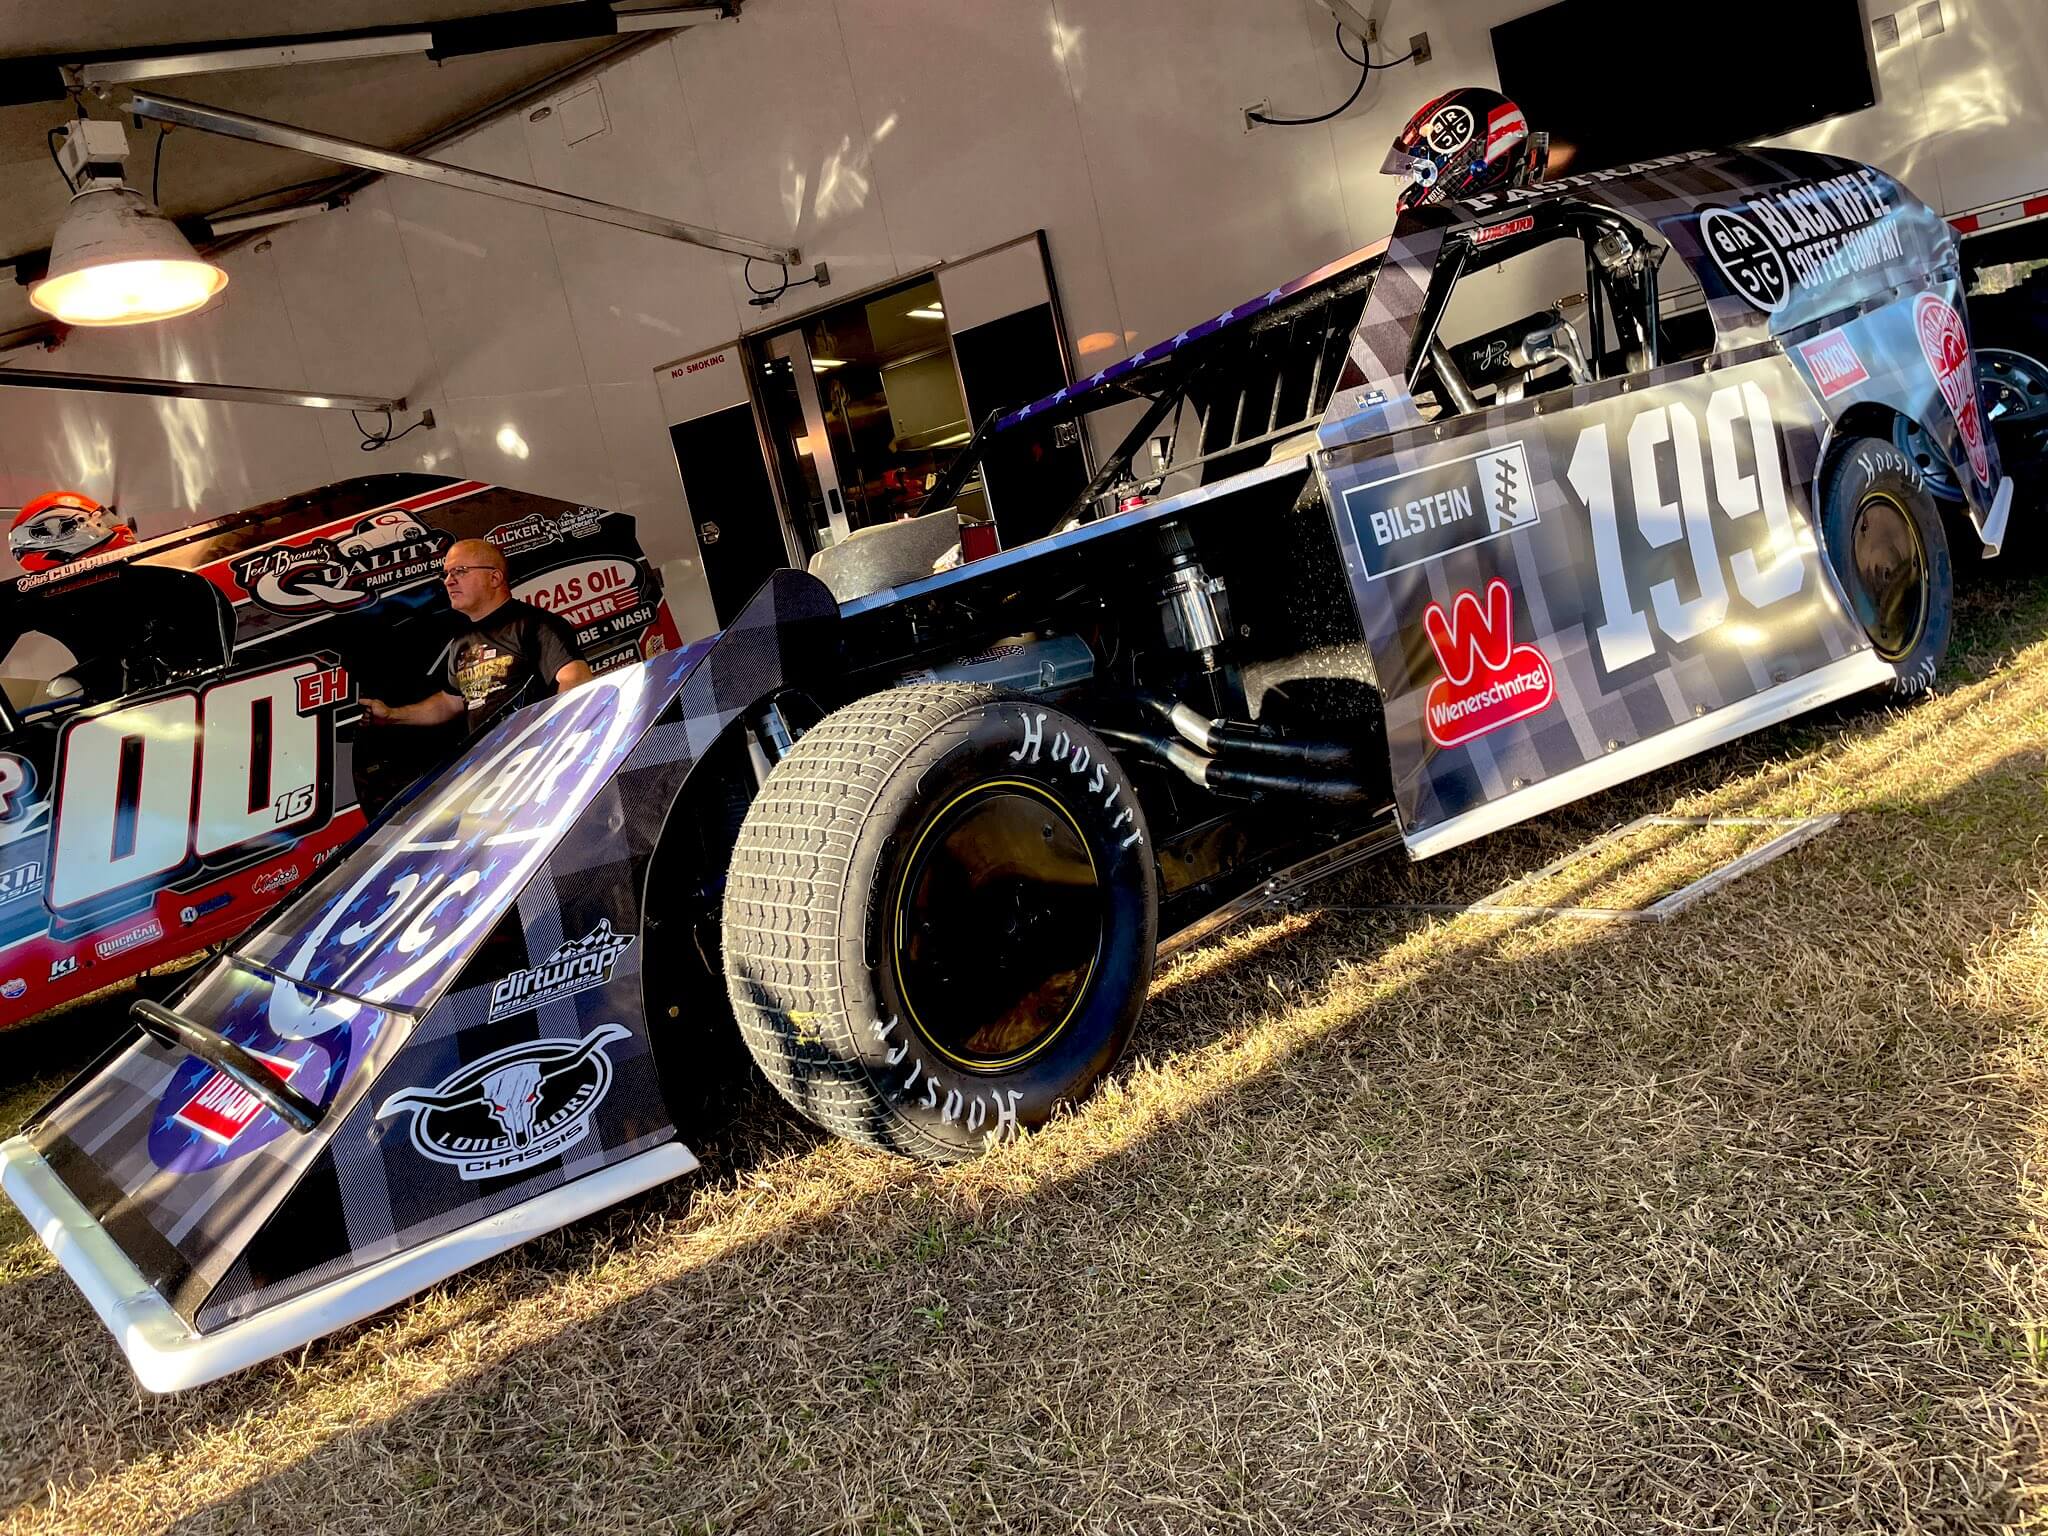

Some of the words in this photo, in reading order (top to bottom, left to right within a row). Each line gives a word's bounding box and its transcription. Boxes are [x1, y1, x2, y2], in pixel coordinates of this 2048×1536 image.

[1464, 150, 1717, 211] PASTRANA
[1747, 184, 1842, 247] BLACK
[1818, 169, 1891, 226] RIFLE
[1787, 237, 1850, 289] COFFEE
[1841, 219, 1903, 272] COMPANY
[671, 368, 684, 379] NO
[686, 354, 725, 374] SMOKING
[486, 524, 541, 545] SLICKER
[1370, 487, 1474, 547] BILSTEIN
[1566, 381, 1807, 673] 199
[240, 556, 269, 583] Ted
[272, 543, 331, 577] Brown's
[257, 537, 443, 606] QUALITY
[366, 572, 393, 588] PAINT
[404, 562, 428, 577] BODY
[430, 557, 447, 570] SHO
[587, 565, 626, 593] OIL
[611, 607, 652, 631] WASH
[298, 670, 348, 711] EH
[1431, 663, 1548, 728] Wienerschnitzel
[52, 662, 319, 908] 00
[274, 783, 315, 823] 16
[51, 955, 75, 976] K1
[495, 946, 618, 1004] dirtwrap
[436, 1132, 509, 1151] LONG
[534, 1083, 596, 1135] HORN
[465, 1123, 583, 1172] CHASSIS
